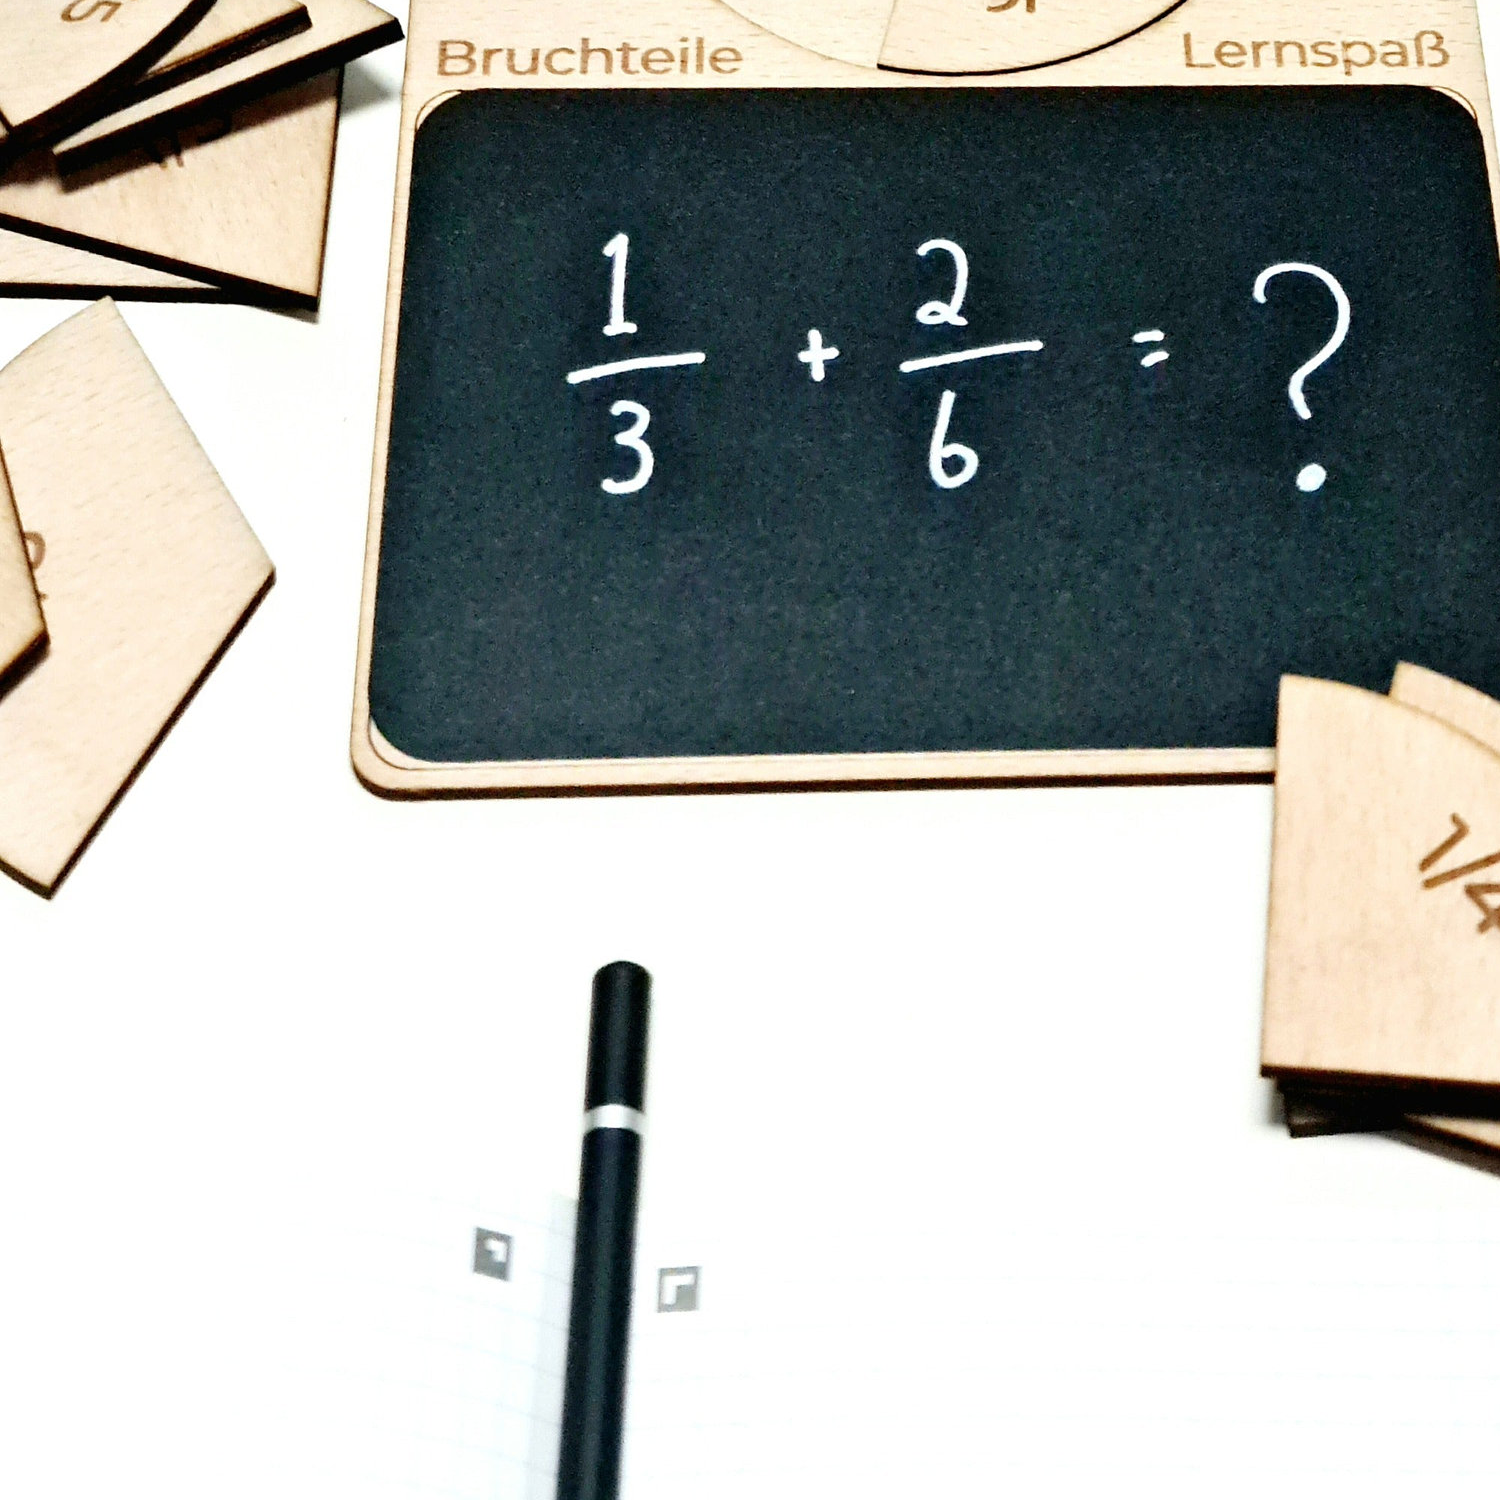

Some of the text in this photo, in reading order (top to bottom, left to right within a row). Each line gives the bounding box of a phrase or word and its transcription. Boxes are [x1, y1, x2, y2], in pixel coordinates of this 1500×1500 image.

[436, 37, 743, 77] Bruchteile
[1183, 30, 1450, 71] Lernspaß
[602, 232, 638, 336] 1
[915, 238, 969, 326] 2
[1252, 261, 1351, 492] ?
[600, 399, 655, 495] 3
[928, 389, 979, 489] 6
